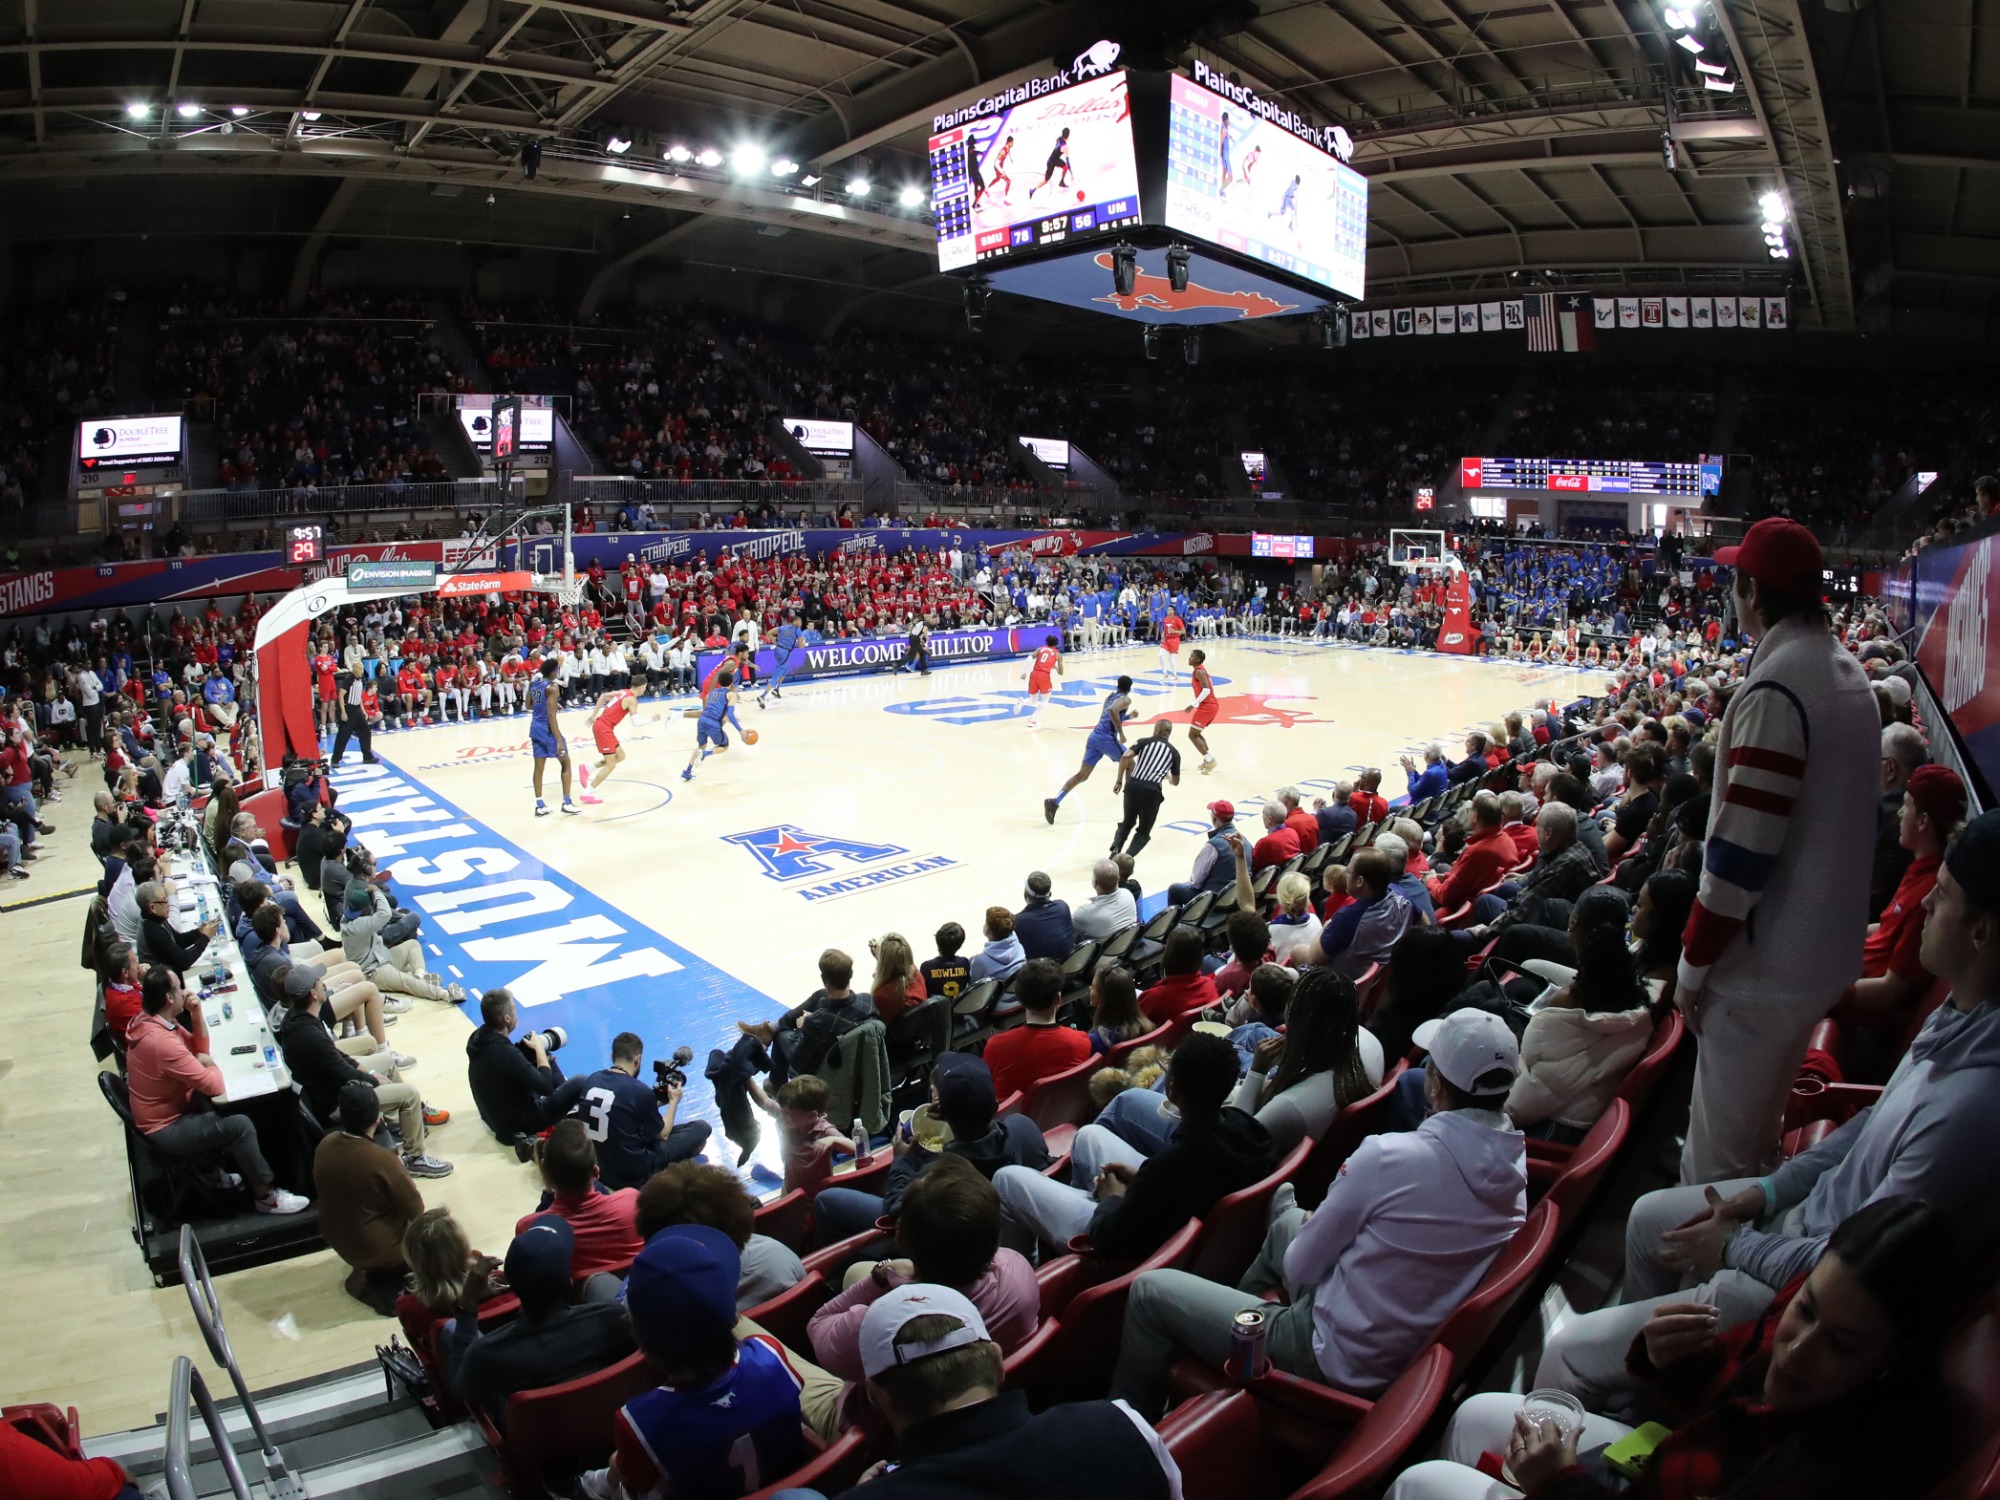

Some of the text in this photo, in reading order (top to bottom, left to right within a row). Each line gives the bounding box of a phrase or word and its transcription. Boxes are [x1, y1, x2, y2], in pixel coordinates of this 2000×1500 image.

[1107, 201, 1127, 215] UM
[1041, 216, 1068, 233] 9:57
[1075, 214, 1092, 228] 56
[980, 232, 1029, 246] SMU 78
[1505, 303, 1521, 325] R
[534, 456, 549, 464] 212
[81, 474, 99, 484] 210
[164, 469, 179, 478] 211
[1417, 496, 1432, 509] 29
[293, 526, 321, 540] 9:57
[553, 538, 563, 546] 111
[1031, 537, 1046, 552] PONY
[1183, 535, 1214, 555] MUSTANGS
[1255, 541, 1269, 550] 78
[1297, 542, 1310, 551] 56
[294, 542, 314, 561] 29
[445, 547, 494, 563] ESPN
[640, 538, 691, 561] STAMPEDE
[99, 567, 113, 576] 110
[171, 562, 182, 570] 111
[363, 569, 432, 579] ENVISION IMAGING
[1040, 652, 1049, 663] 0
[796, 855, 958, 901] AMERICAN
